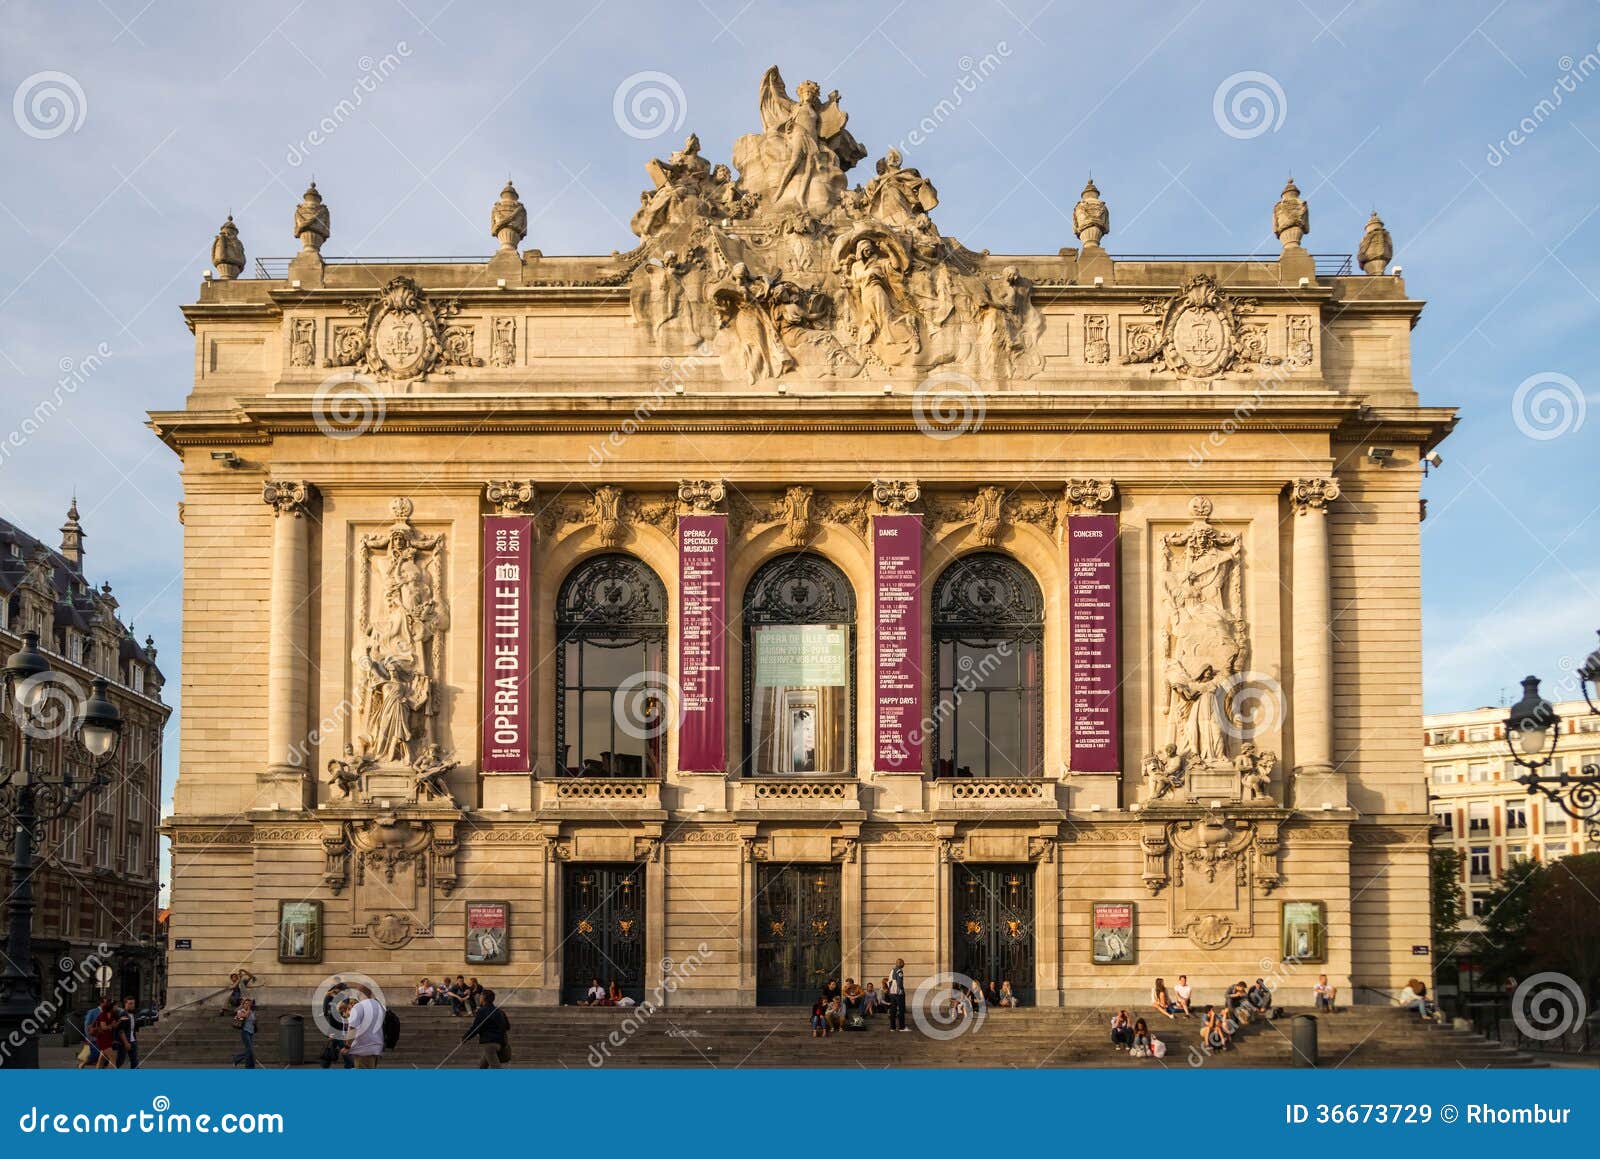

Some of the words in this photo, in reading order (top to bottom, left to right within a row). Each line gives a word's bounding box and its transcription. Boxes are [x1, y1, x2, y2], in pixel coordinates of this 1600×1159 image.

[496, 530, 507, 552] 2013
[509, 529, 520, 552] 2014
[684, 529, 706, 537] OPÉRAS
[496, 587, 519, 638] LILLE
[495, 645, 518, 670] DE
[494, 676, 518, 744] OPERA
